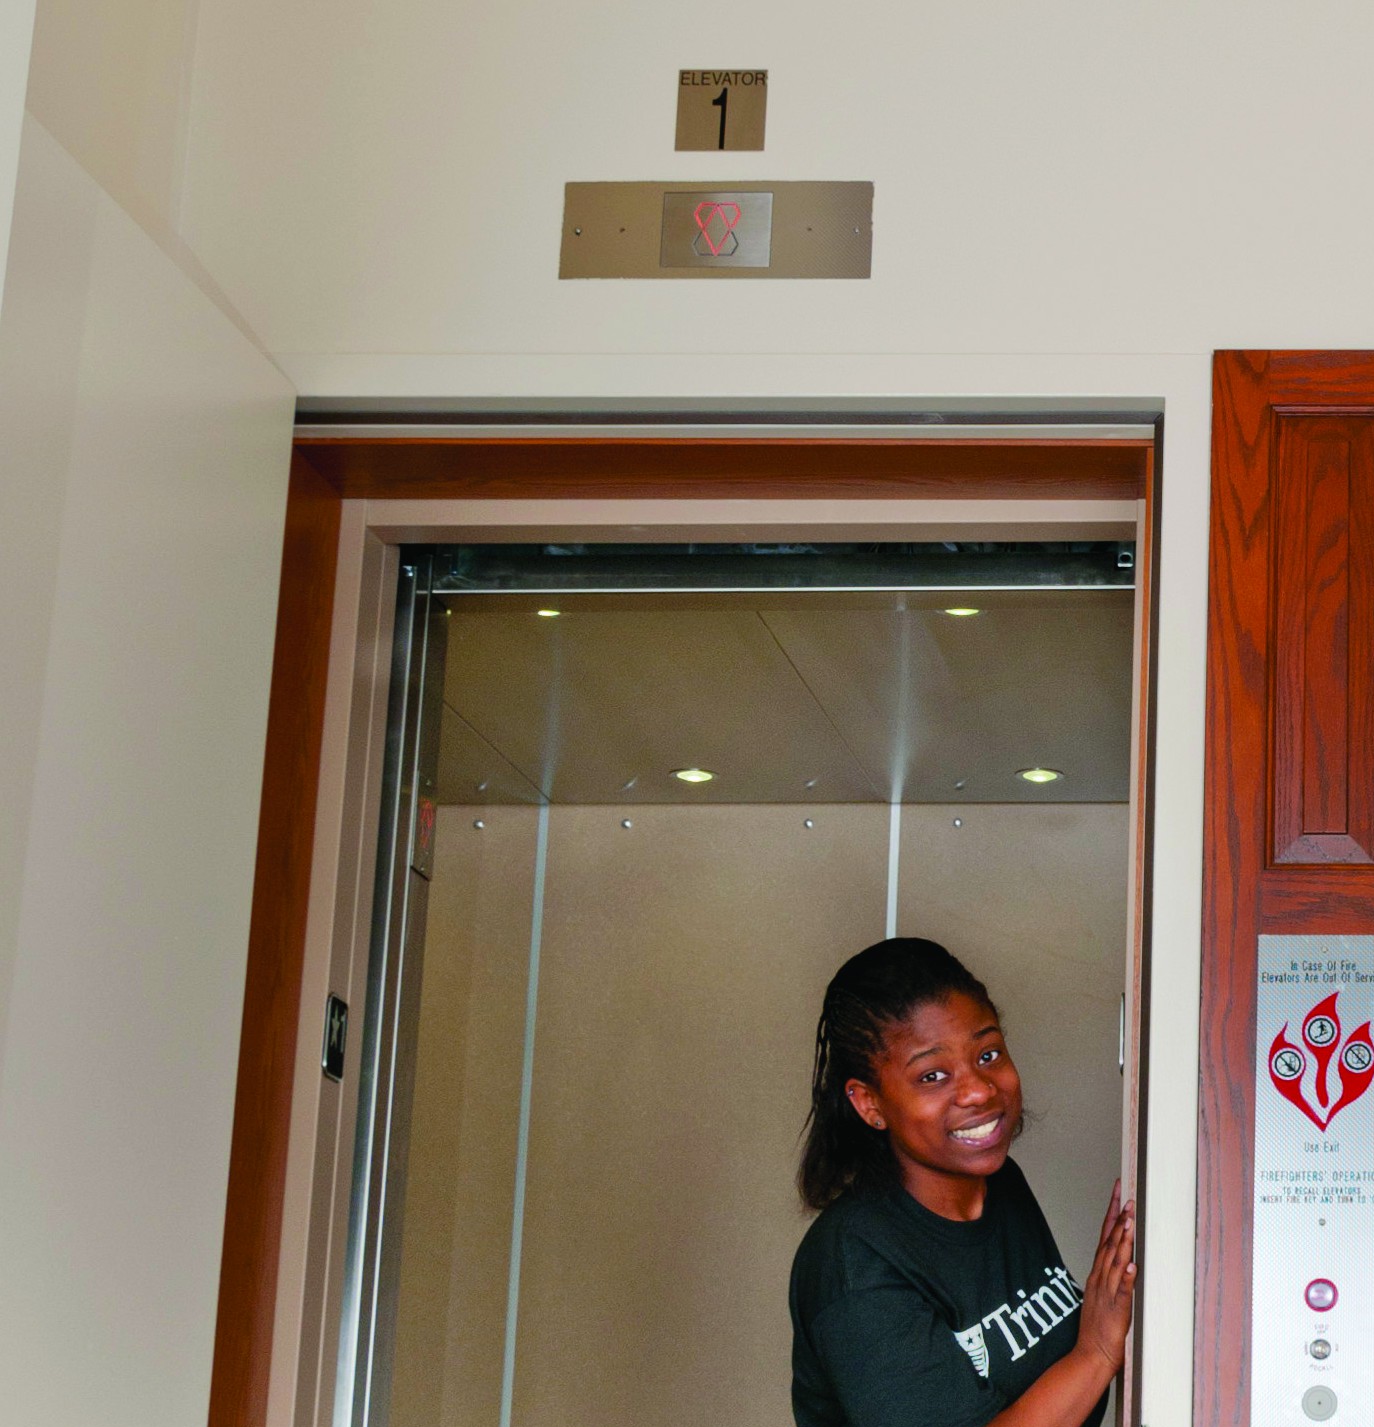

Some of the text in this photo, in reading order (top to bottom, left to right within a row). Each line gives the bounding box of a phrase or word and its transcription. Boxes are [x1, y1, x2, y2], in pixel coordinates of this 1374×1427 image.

[680, 71, 767, 86] ELEVATOR
[712, 87, 728, 150] 1
[1302, 960, 1322, 971] Case
[1327, 960, 1336, 971] Of
[1261, 972, 1300, 983] Elevators
[1304, 972, 1318, 983] Are
[1322, 972, 1337, 983] Out
[1304, 1141, 1340, 1153] Use Exit
[981, 1266, 1083, 1361] Trinit
